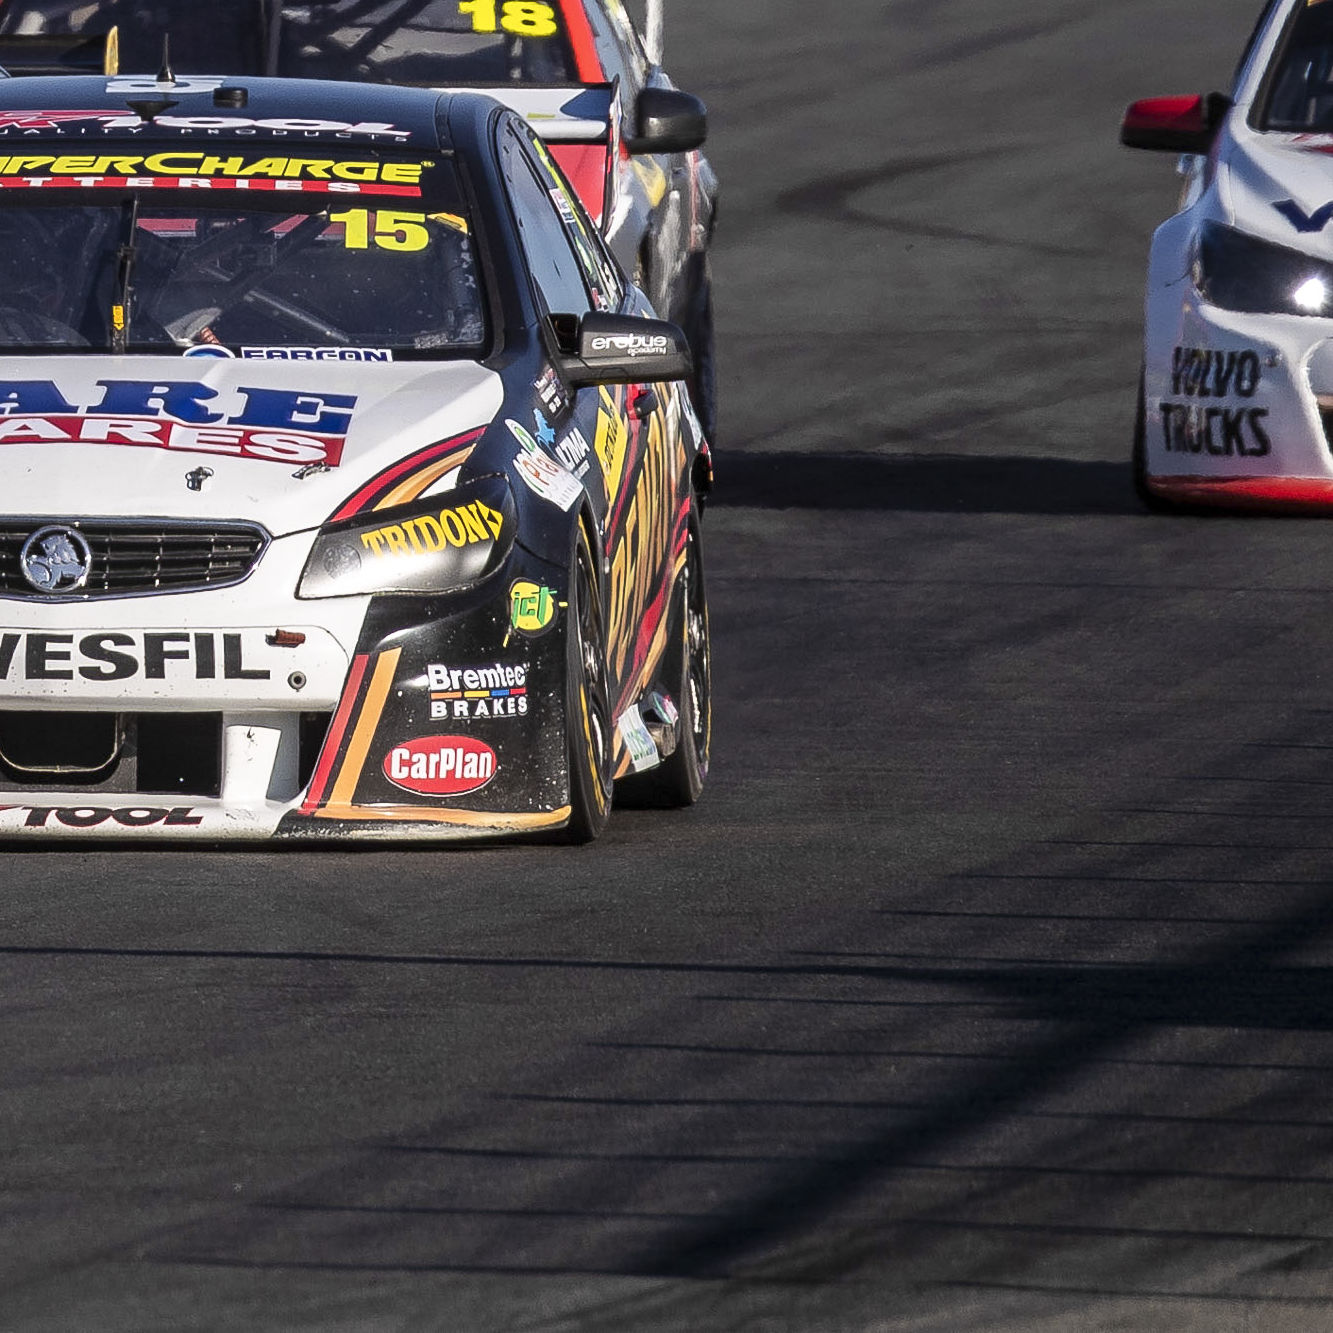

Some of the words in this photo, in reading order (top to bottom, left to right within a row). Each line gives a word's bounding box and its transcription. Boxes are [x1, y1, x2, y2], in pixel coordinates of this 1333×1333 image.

[329, 209, 430, 252] 15
[591, 335, 667, 350] erebus
[1171, 347, 1261, 399] VOLVO
[1160, 402, 1271, 456] TRUCKS
[361, 500, 489, 559] TRIDON
[428, 664, 527, 691] Bremtec
[430, 696, 528, 719] BRAKES
[391, 747, 493, 780] CarPlan
[23, 805, 205, 828] TOOL
